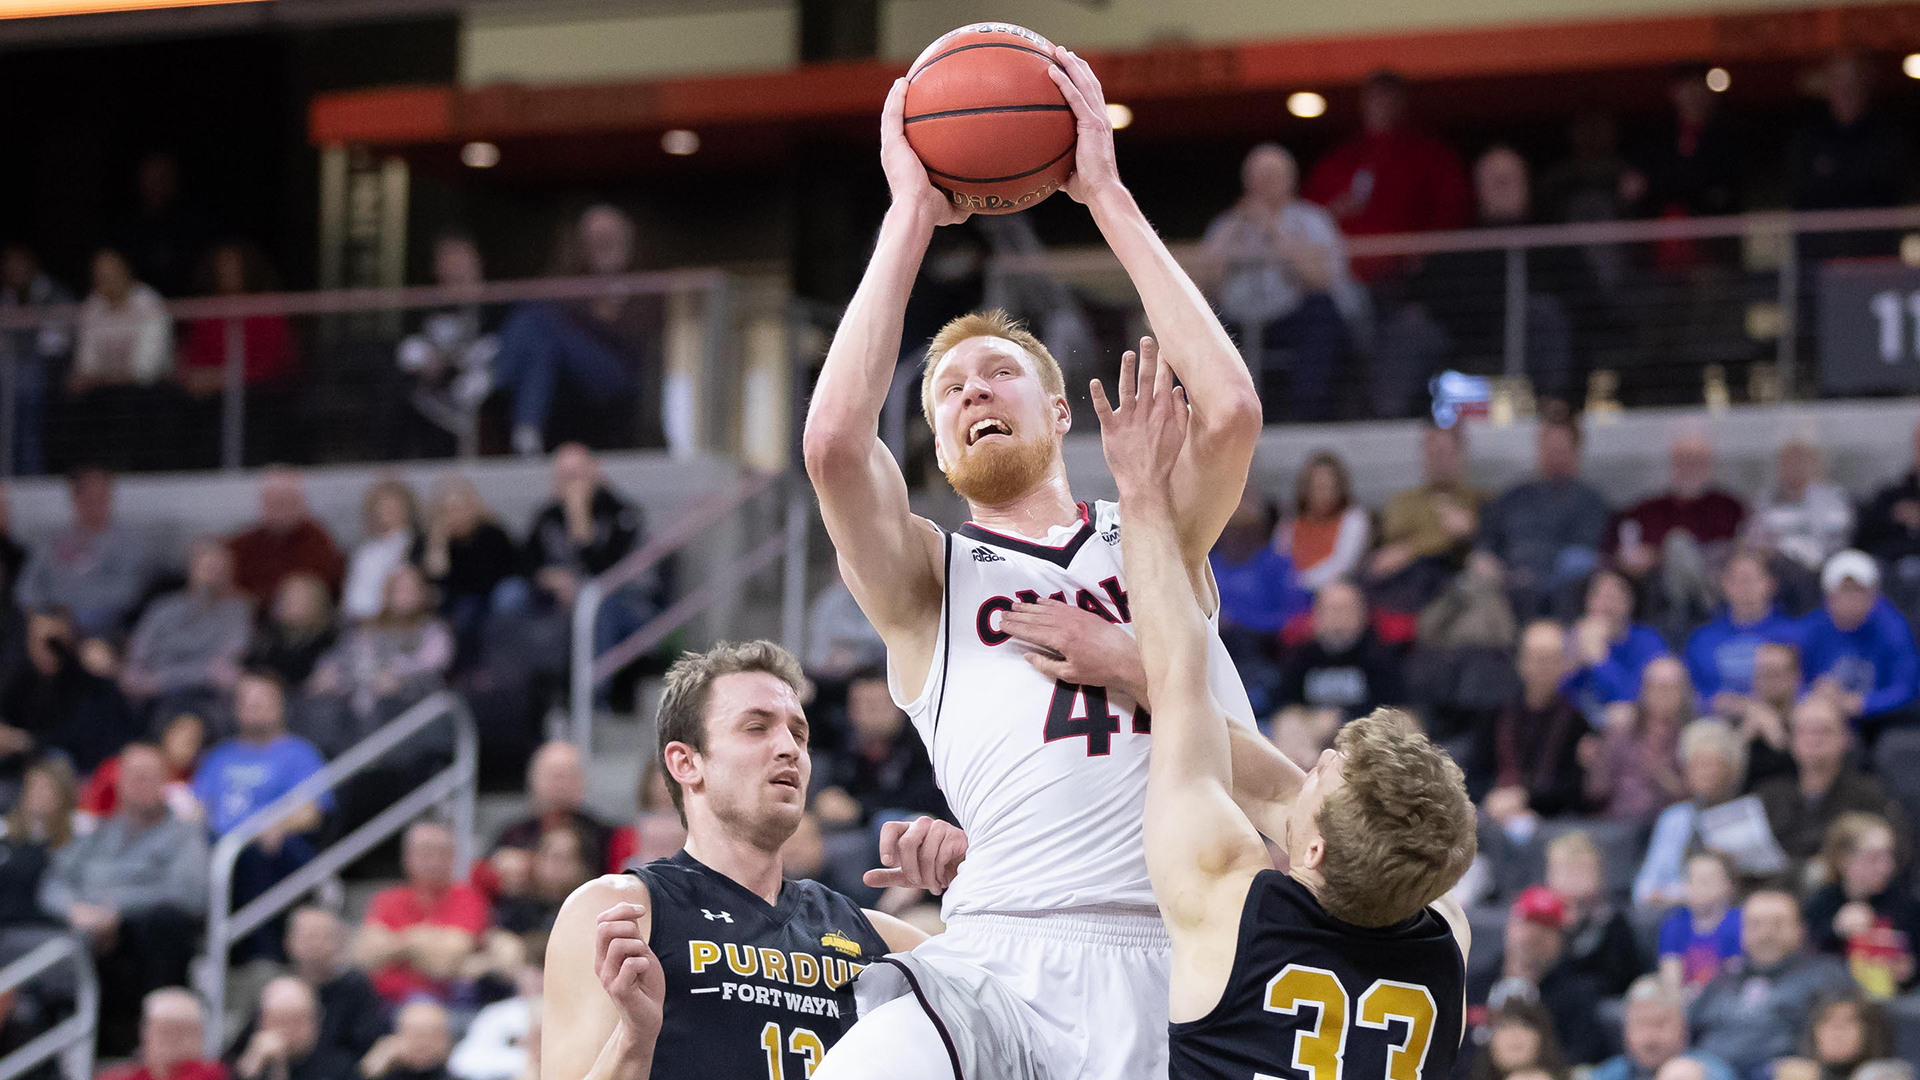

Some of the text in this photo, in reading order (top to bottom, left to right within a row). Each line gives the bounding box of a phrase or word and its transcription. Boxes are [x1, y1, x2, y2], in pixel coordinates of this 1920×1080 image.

[976, 575, 1132, 646] OAH
[1043, 678, 1151, 757] 4
[722, 982, 840, 1020] FORT WAYN
[1253, 963, 1438, 1080] 33
